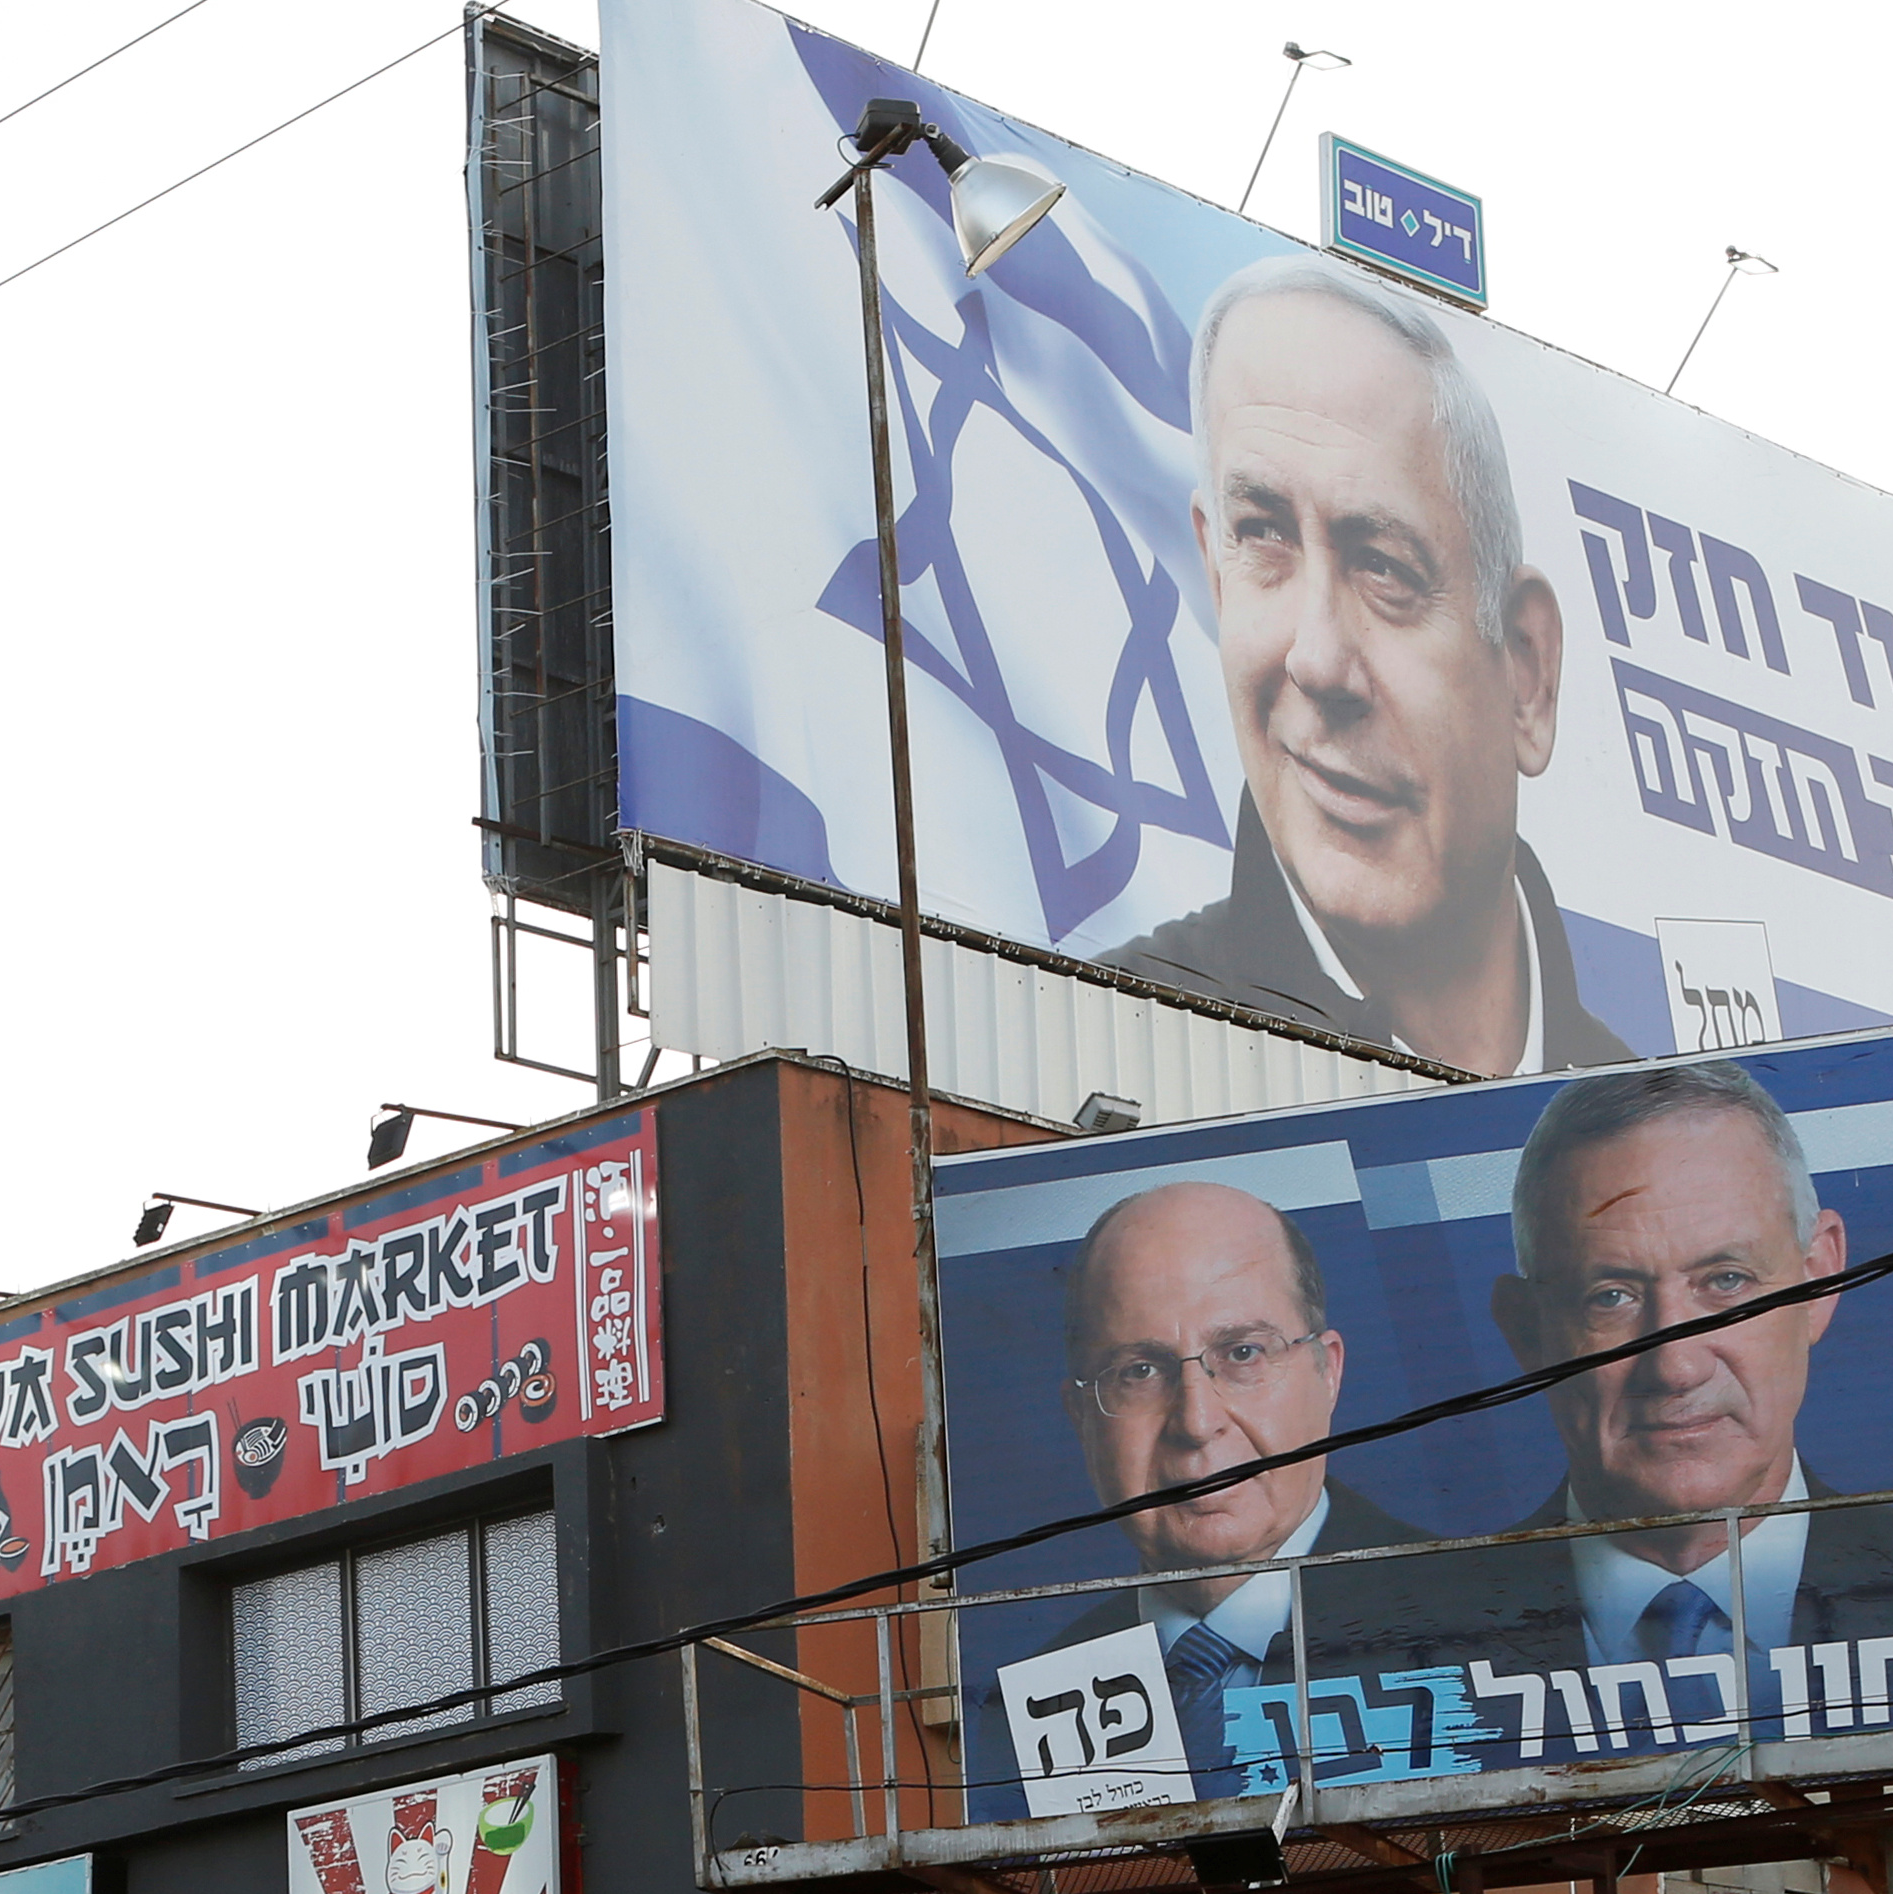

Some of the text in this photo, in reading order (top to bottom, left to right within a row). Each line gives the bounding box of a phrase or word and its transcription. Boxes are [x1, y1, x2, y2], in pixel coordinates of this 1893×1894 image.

[1343, 173, 1472, 264] דיל טוב
[1567, 477, 1791, 675] חזק
[1629, 688, 1860, 862] חזקה
[67, 1275, 260, 1428] SUSHI
[272, 1174, 567, 1364] MARKET
[1027, 1673, 1154, 1777] פה
[1463, 1654, 1744, 1758] כחול
[1077, 1788, 1102, 1813] לבן
[1106, 1780, 1144, 1801] כחול
